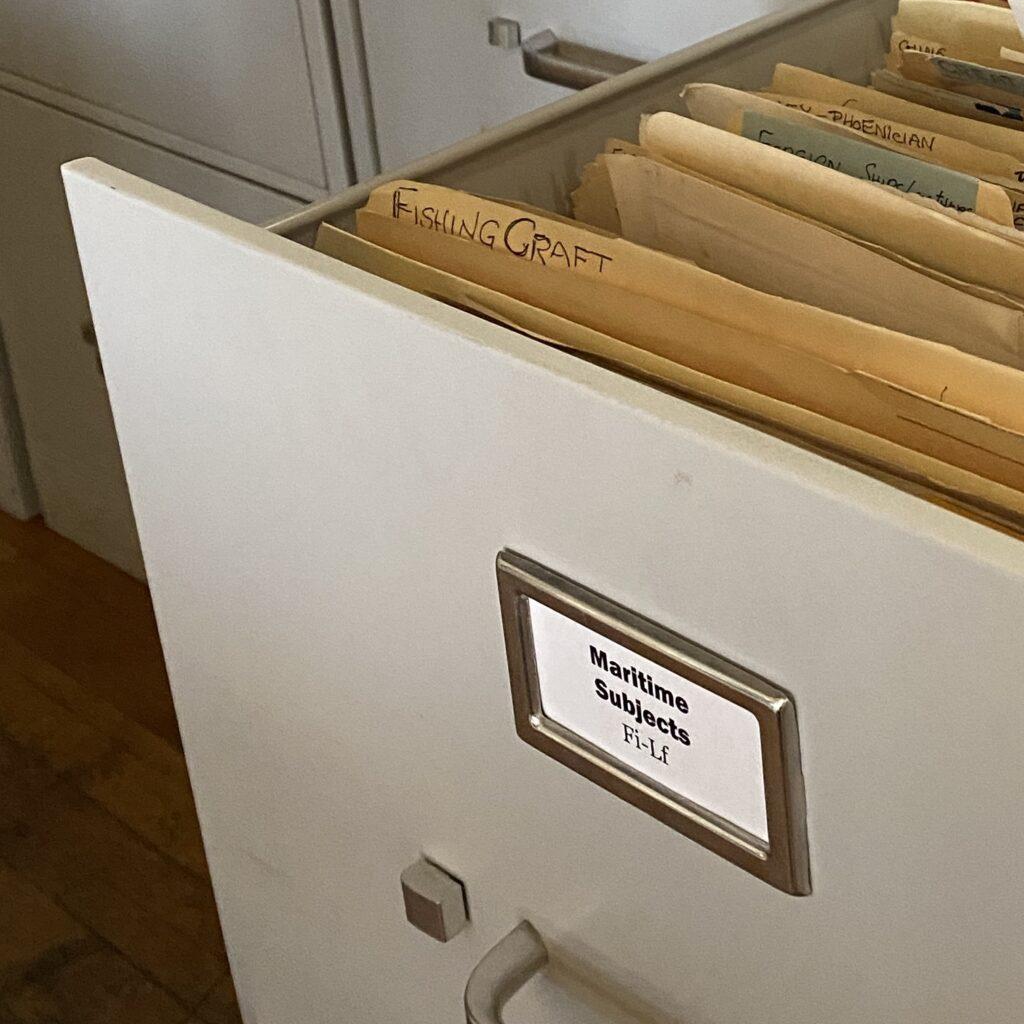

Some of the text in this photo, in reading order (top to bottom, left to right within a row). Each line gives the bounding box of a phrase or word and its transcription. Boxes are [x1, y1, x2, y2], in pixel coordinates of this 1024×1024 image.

[392, 186, 613, 273] FISHING CRAFT
[589, 645, 690, 714] Maritime
[593, 678, 692, 746] Subjects
[622, 723, 670, 765] Fi-Lf
